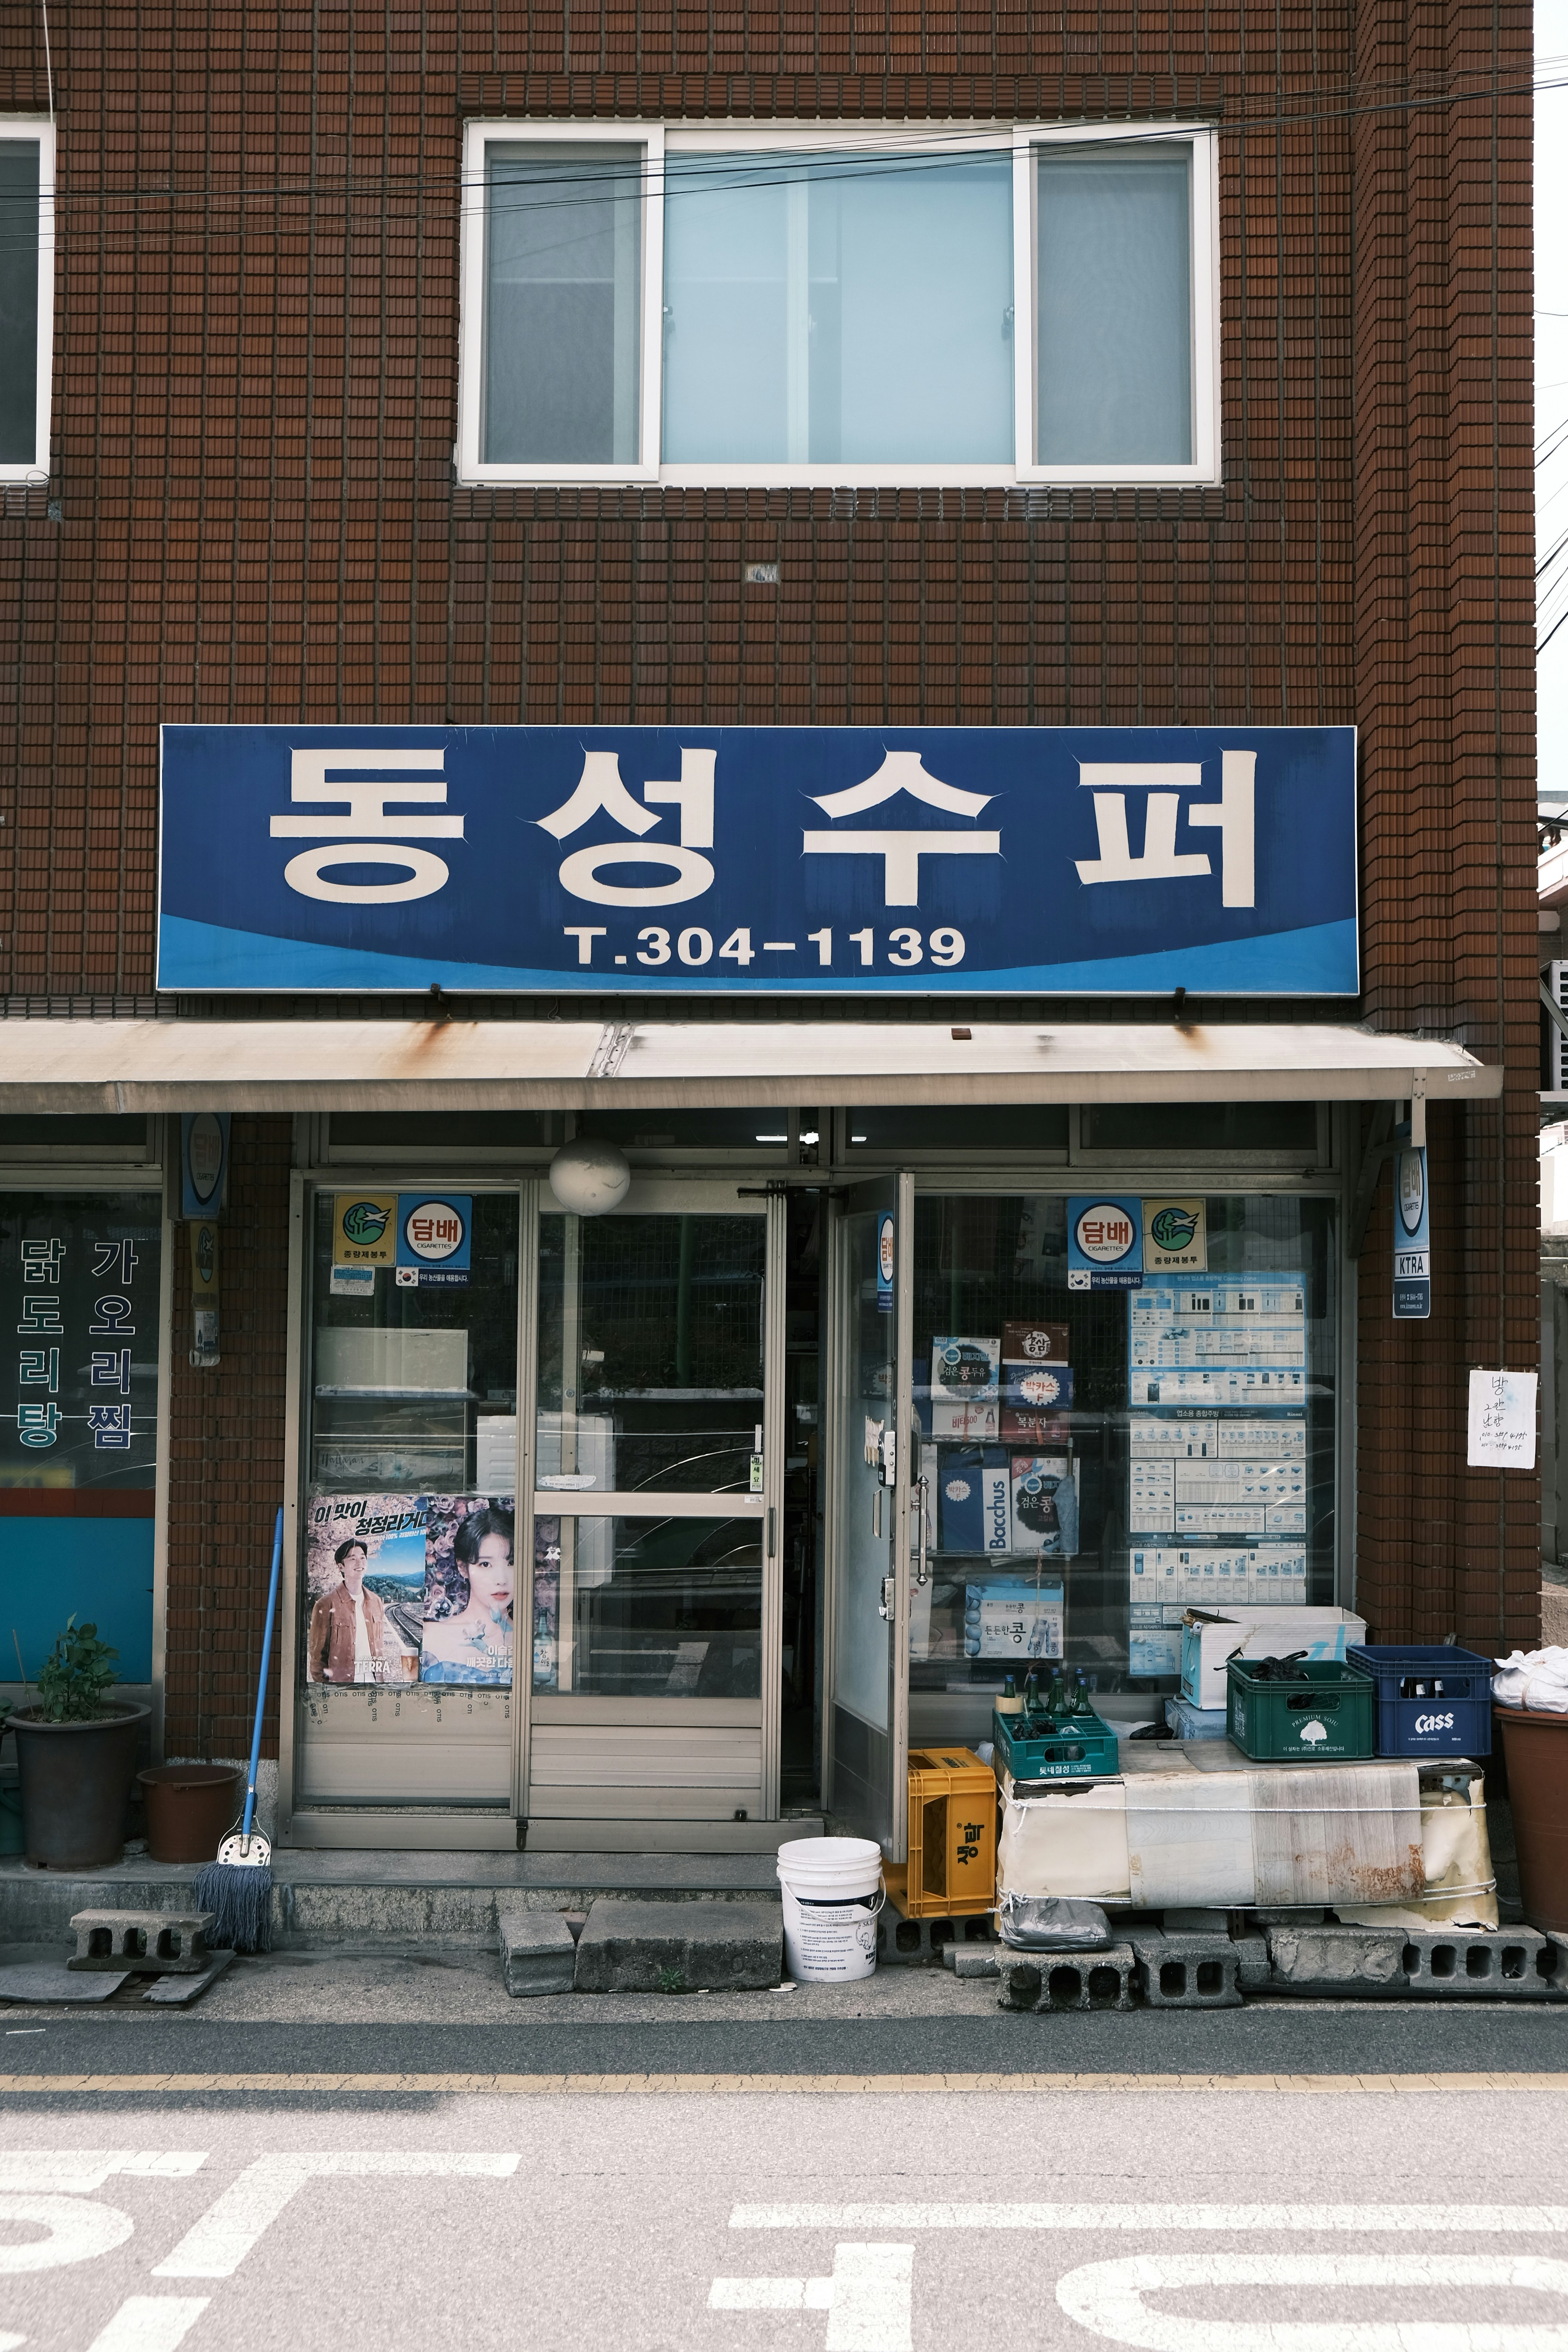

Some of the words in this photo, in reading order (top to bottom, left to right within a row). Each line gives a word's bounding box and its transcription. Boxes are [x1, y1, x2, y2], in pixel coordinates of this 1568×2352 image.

[269, 747, 1257, 908] 동성수퍼
[563, 926, 967, 967] T.304-1139
[194, 1133, 220, 1169] 담배
[197, 1173, 214, 1181] CIGARETTES
[412, 1219, 458, 1242] 담배
[1083, 1222, 1129, 1244] 담배
[344, 1250, 387, 1259] 종량제봉투
[1155, 1256, 1198, 1265] 종량제봉투
[1400, 1255, 1423, 1275] KTRA
[17, 1238, 66, 1449] 닭도리탕
[89, 1239, 139, 1449] 가오리찜
[962, 1352, 989, 1361] 베지밀
[1026, 1381, 1055, 1392] 박카스
[1492, 1376, 1508, 1395] 방
[1037, 1393, 1044, 1401] F
[1018, 1416, 1047, 1428] 복분자
[1483, 1413, 1504, 1428] 남향
[322, 1452, 366, 1467] Hallasan
[314, 1505, 332, 1524] 이
[332, 1500, 368, 1521] 맛이
[986, 1480, 1006, 1550] Bacchus
[1049, 1642, 1057, 1652] 콩
[466, 1657, 496, 1668] 깨끗한
[540, 1649, 550, 1667] 참이슬
[354, 1661, 391, 1674] TERRA
[1291, 1715, 1321, 1727] PREMIUM
[1323, 1716, 1338, 1726] SOJU
[1415, 1712, 1454, 1734] Cass
[957, 1822, 985, 1865] 생탁
